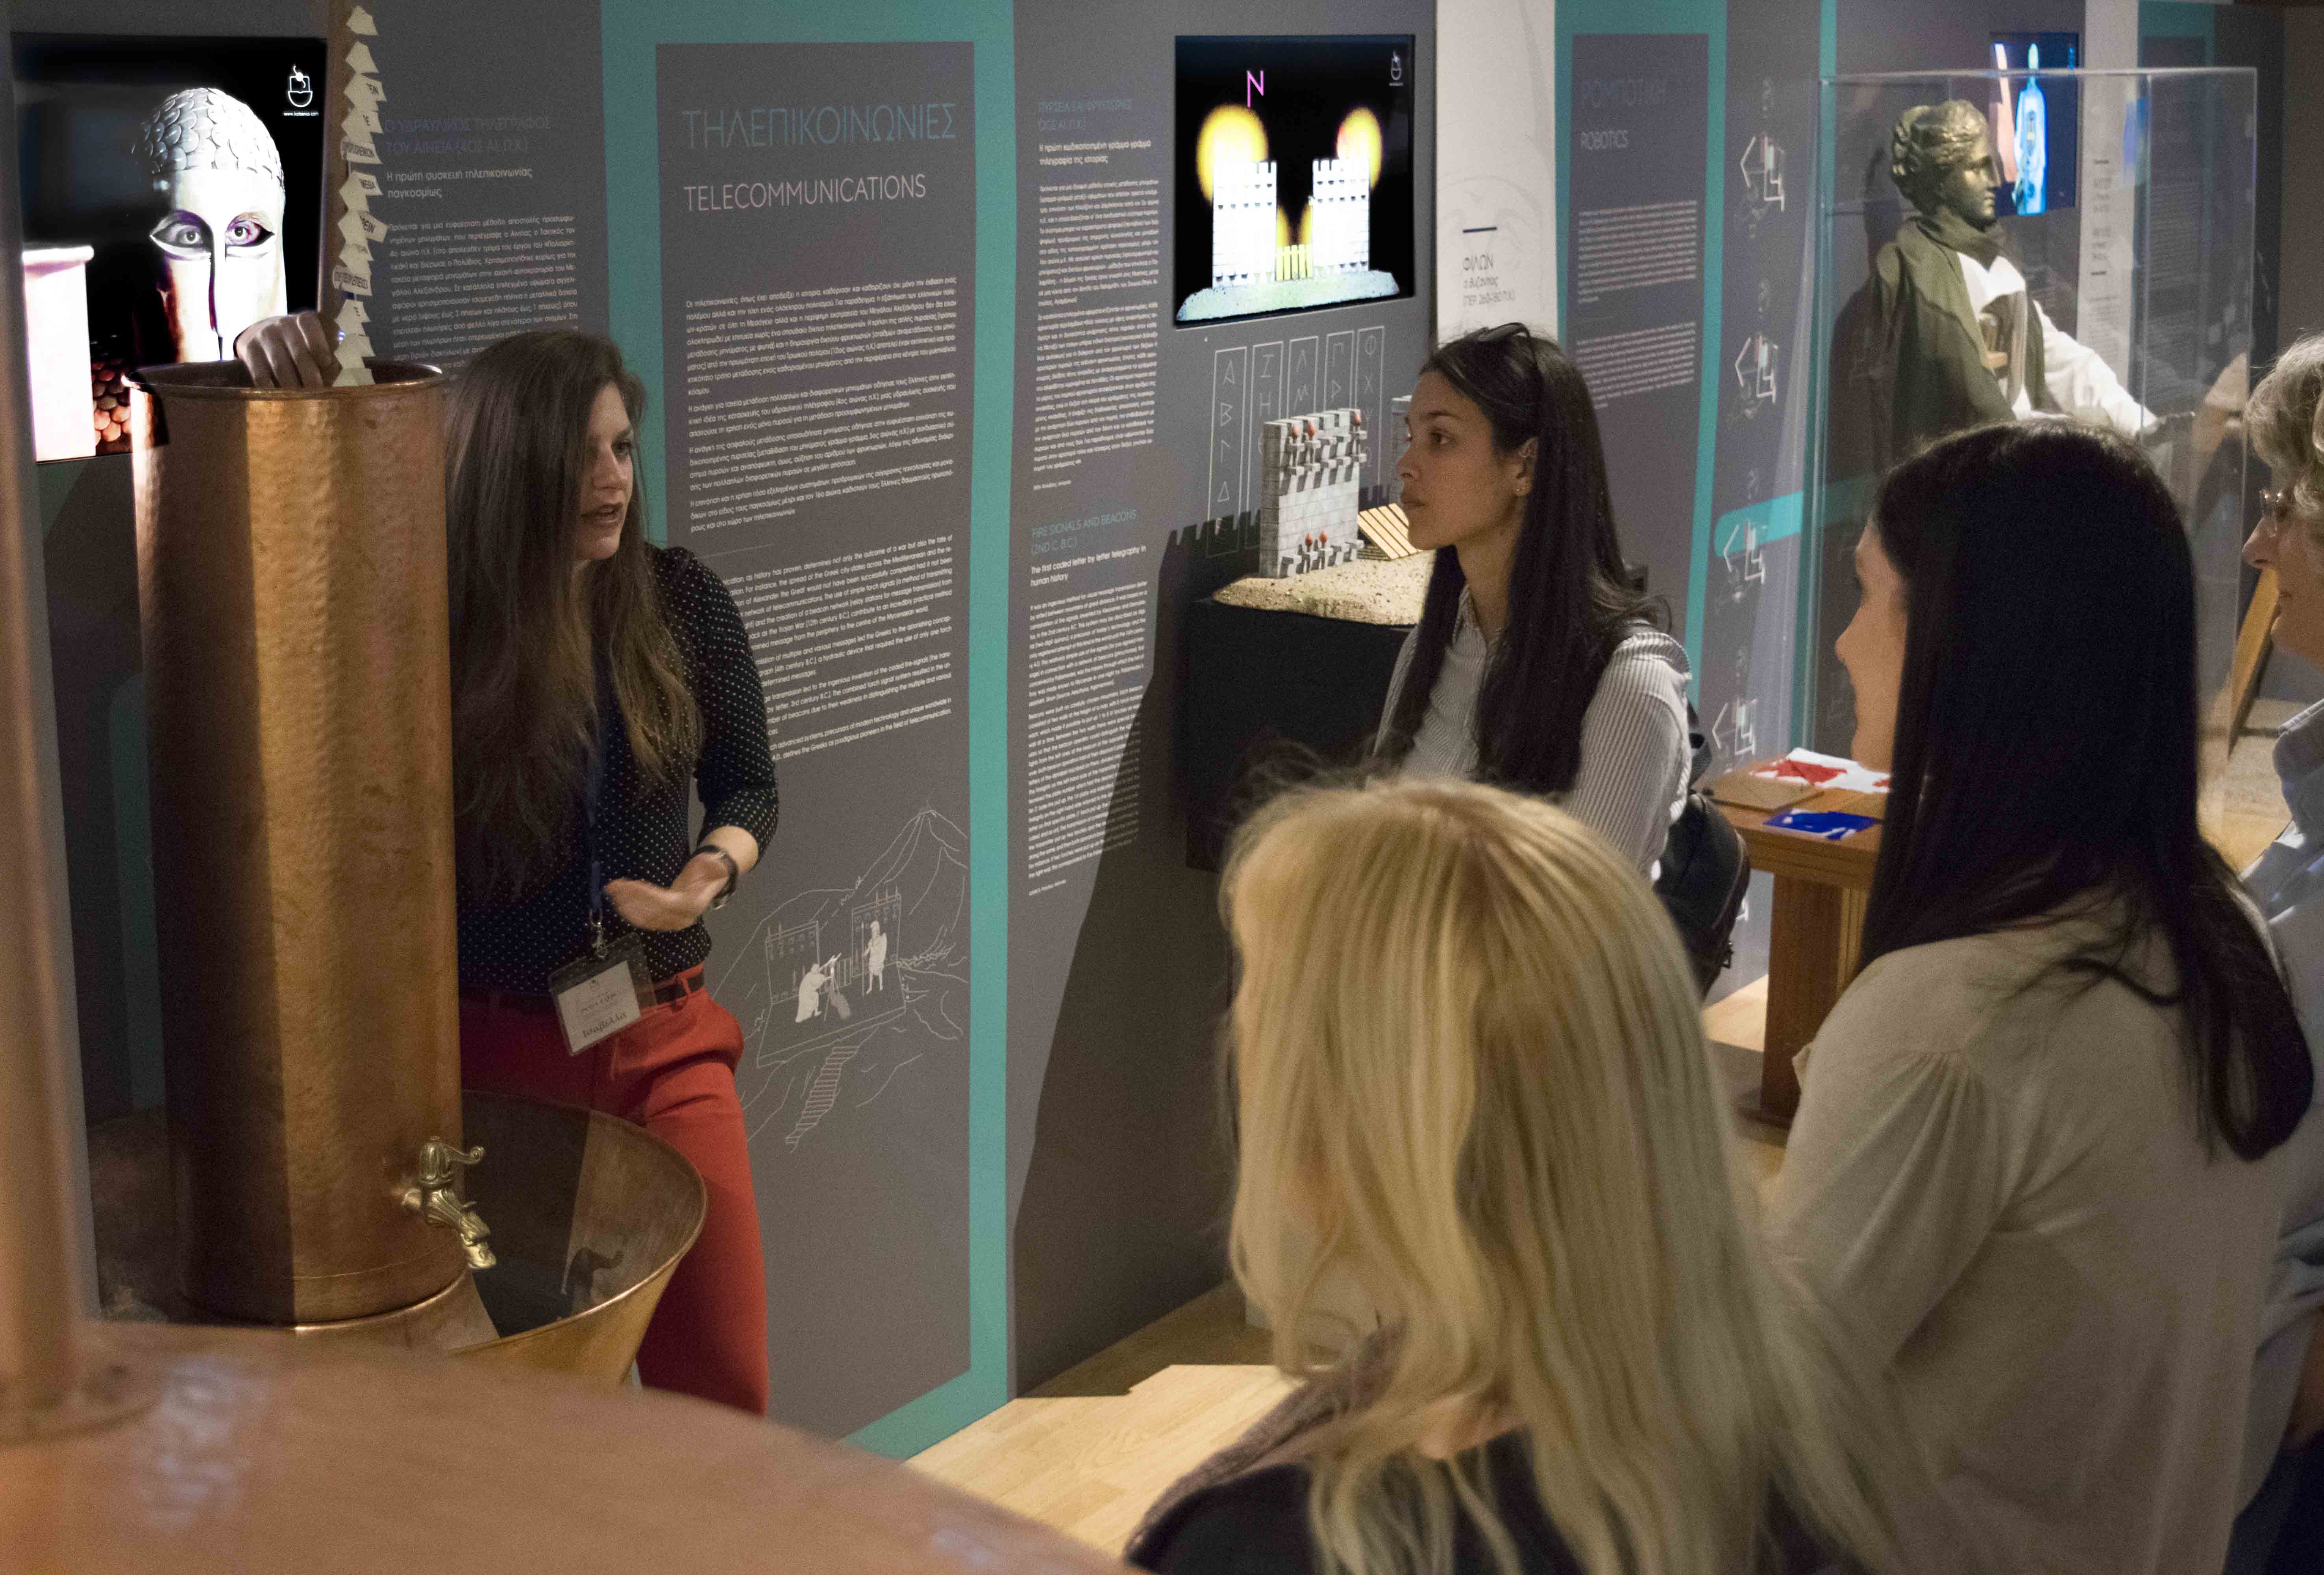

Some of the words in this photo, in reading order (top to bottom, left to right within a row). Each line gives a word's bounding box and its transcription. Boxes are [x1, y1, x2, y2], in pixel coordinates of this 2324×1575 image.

[682, 102, 957, 148] ΤΗΛΕΠΙΚΟΙΝΩΝΙΕΣ
[1580, 130, 1628, 150] ROBOTICS
[684, 174, 926, 211] TELECOMMUNICATIONS
[754, 570, 770, 580] history
[843, 554, 852, 562] only
[864, 548, 885, 558] outcome
[788, 575, 807, 585] spread
[823, 568, 839, 577] Greek
[866, 560, 882, 569] across
[790, 586, 805, 596] Great
[807, 584, 822, 592] would
[823, 581, 831, 589] not
[833, 578, 845, 587] have
[846, 576, 859, 584] been
[1031, 577, 1049, 586] human
[1050, 573, 1068, 582] history
[776, 611, 797, 622] creation
[809, 605, 829, 615] beacon
[830, 600, 848, 610] network
[865, 593, 883, 603] stations
[891, 587, 912, 598] message
[942, 578, 952, 586] from
[770, 636, 792, 648] message
[794, 633, 805, 641] from
[856, 618, 871, 627] centre
